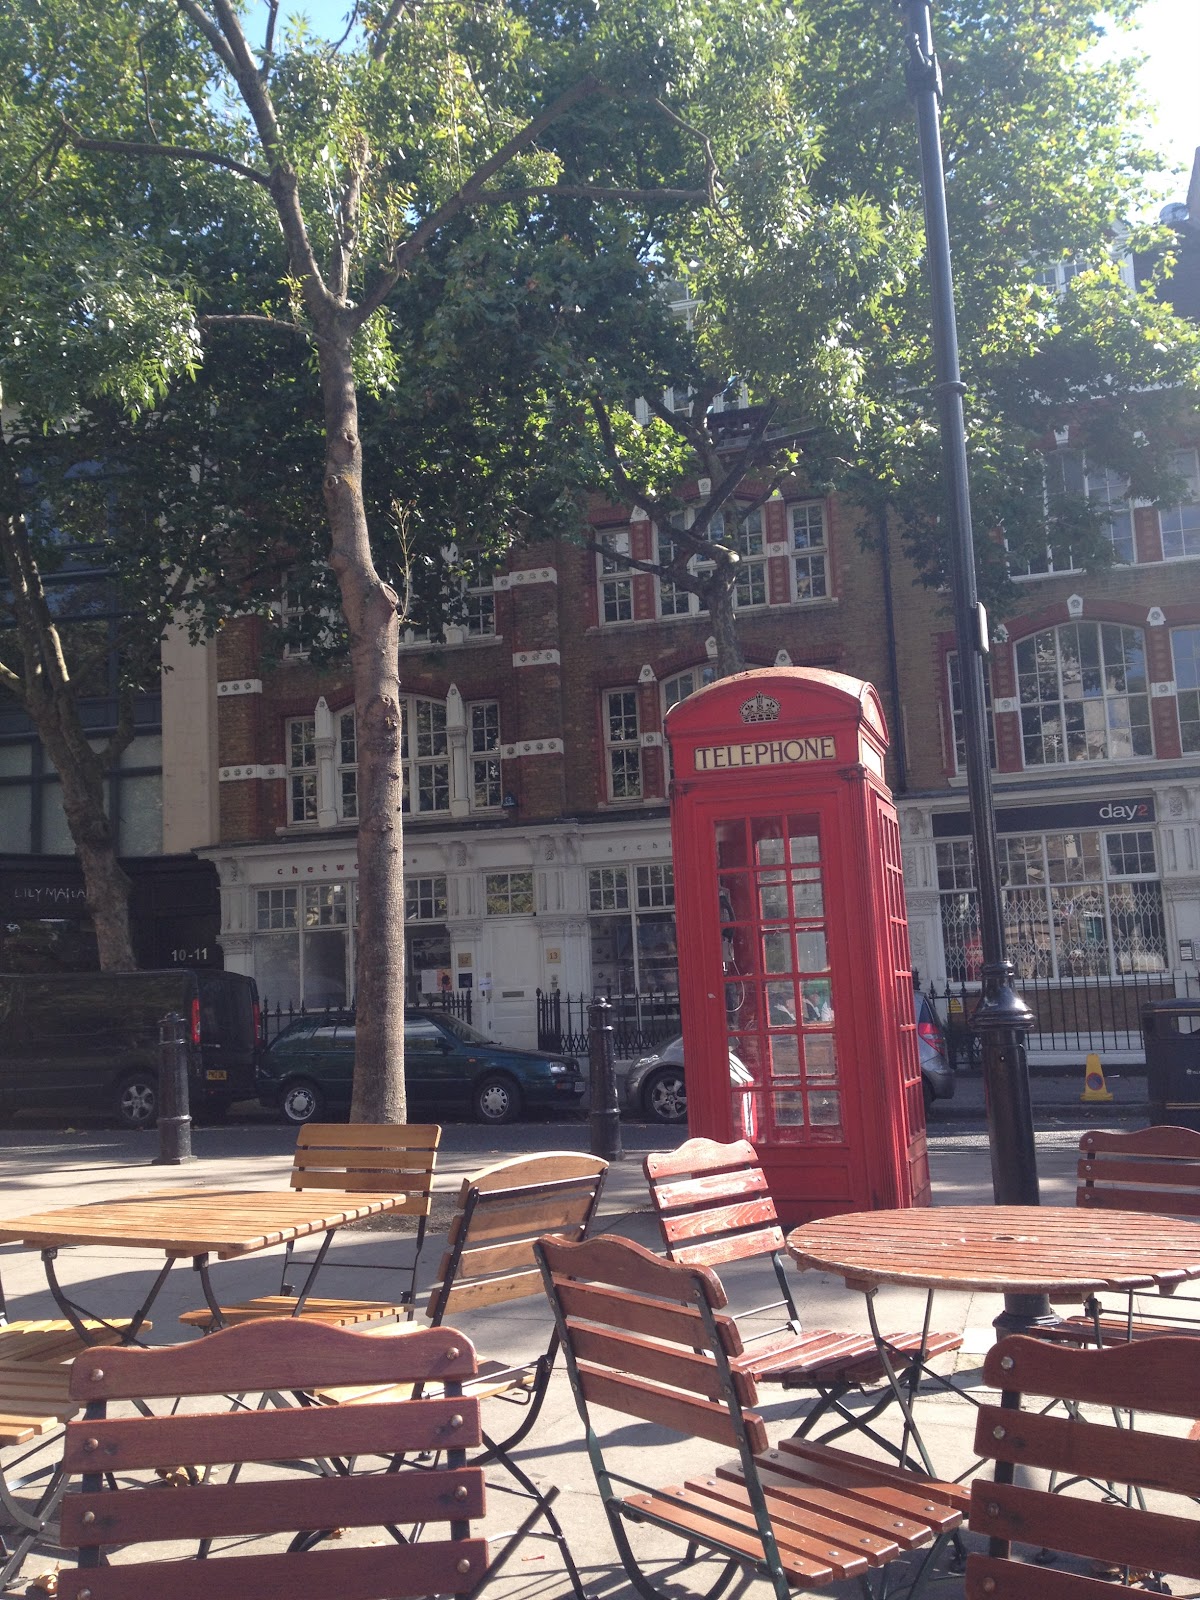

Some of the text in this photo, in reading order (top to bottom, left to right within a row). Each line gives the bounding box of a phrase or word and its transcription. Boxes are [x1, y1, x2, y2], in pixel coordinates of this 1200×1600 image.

[697, 737, 834, 769] TELEPHONE
[1099, 803, 1148, 821] day2
[607, 841, 672, 853] archi
[277, 859, 407, 875] chetwos
[171, 947, 208, 962] 10-11
